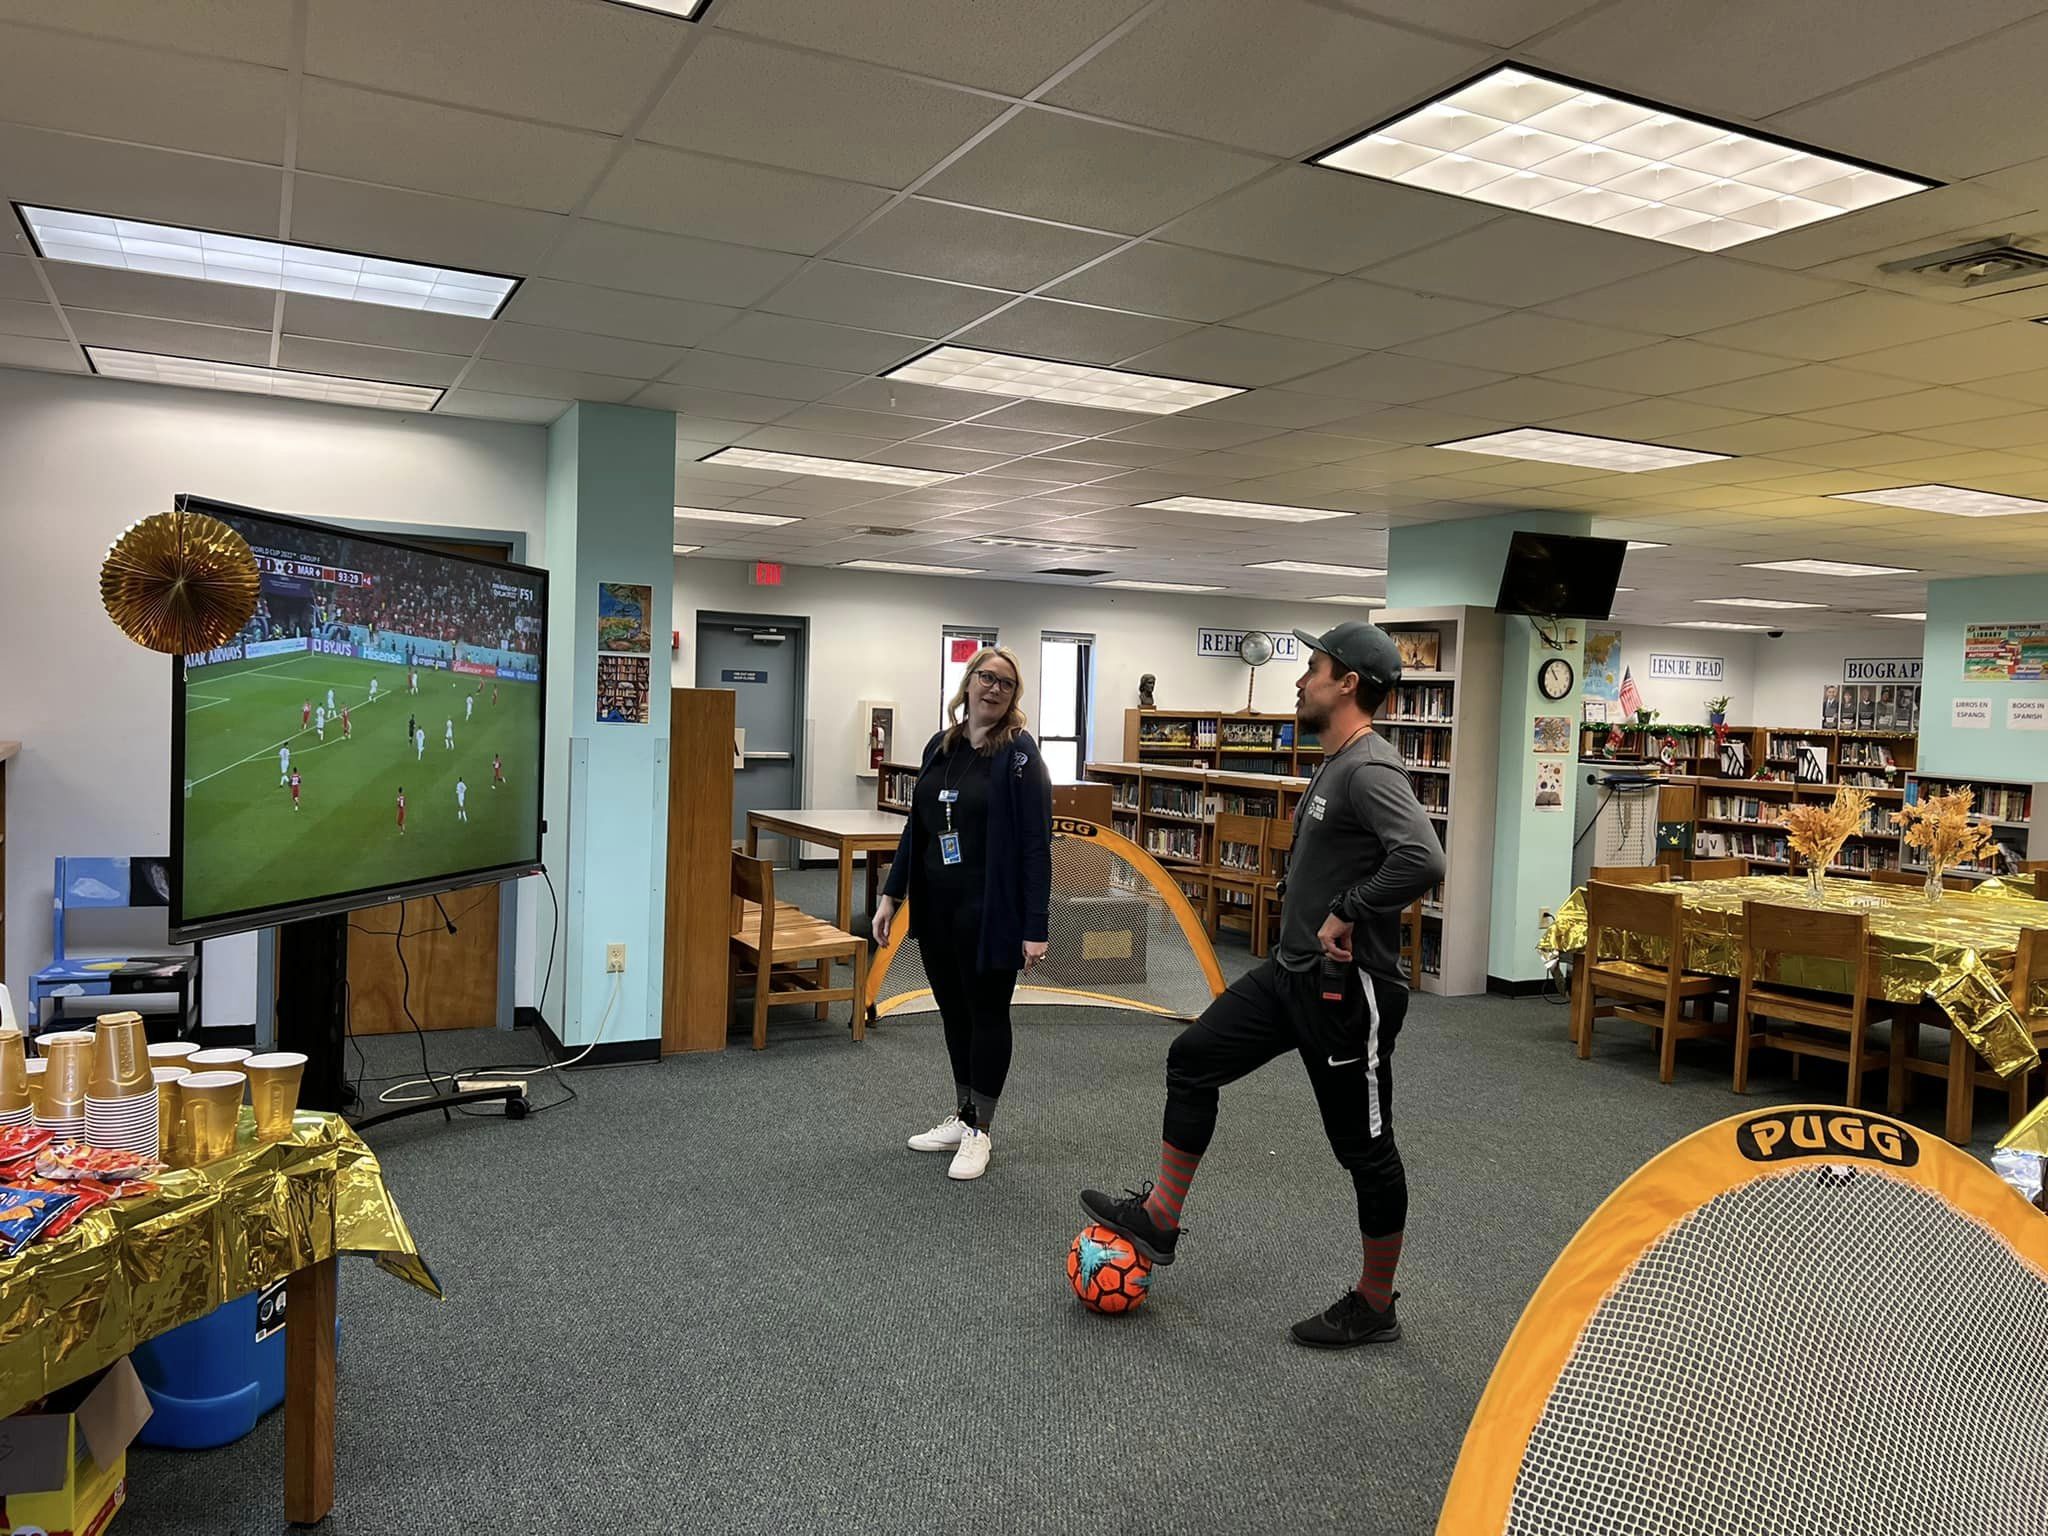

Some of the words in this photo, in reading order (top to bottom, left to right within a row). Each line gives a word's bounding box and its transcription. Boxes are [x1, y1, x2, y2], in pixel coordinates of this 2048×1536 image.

[287, 563, 293, 574] 2
[297, 564, 314, 577] MAR
[756, 563, 781, 585] EXIT
[520, 588, 533, 601] FS1
[323, 640, 353, 657] BYJU'S
[363, 643, 402, 664] Hisense
[1653, 659, 1690, 675] LEISURE
[1696, 661, 1721, 676] READ
[1205, 804, 1215, 816] M
[1697, 840, 1704, 848] U
[1710, 840, 1717, 850] V
[1751, 1115, 1903, 1161] PUGG
